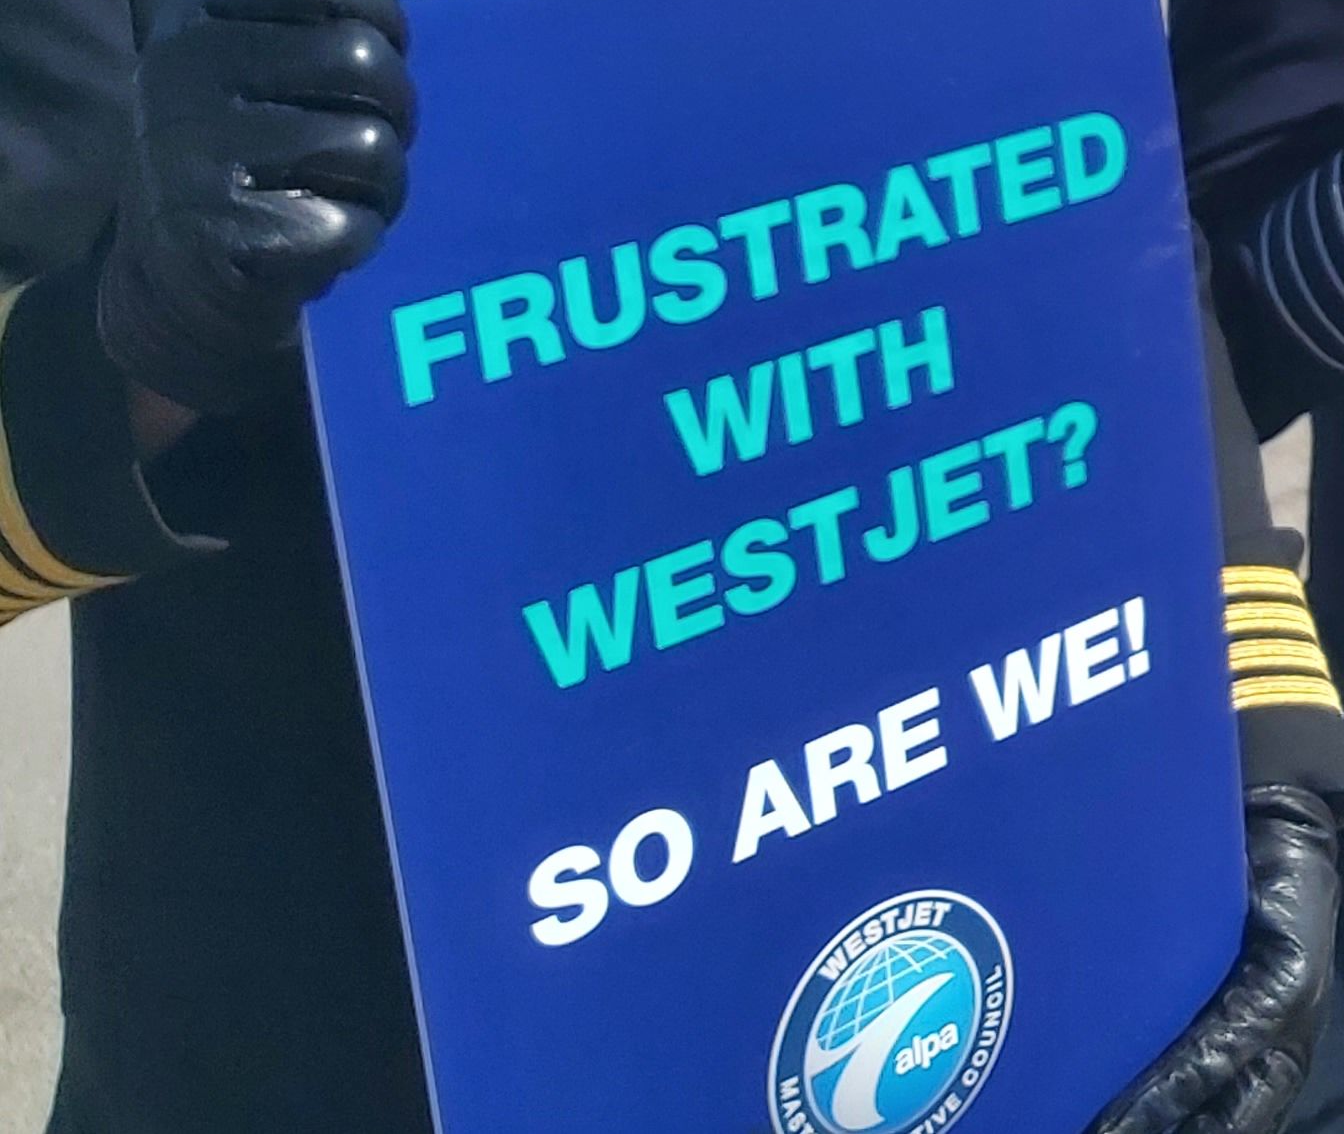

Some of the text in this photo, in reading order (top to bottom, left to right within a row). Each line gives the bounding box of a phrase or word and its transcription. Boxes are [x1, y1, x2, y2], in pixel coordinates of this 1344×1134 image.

[389, 111, 1128, 409] FRUSTRATED
[662, 305, 955, 477] WITH
[521, 400, 1098, 691] WESTJET?
[527, 595, 1152, 948] SO ARE WE!
[818, 900, 953, 982] WESTJET
[961, 964, 1004, 1087] COUNCIL
[893, 1022, 959, 1076] alpa
